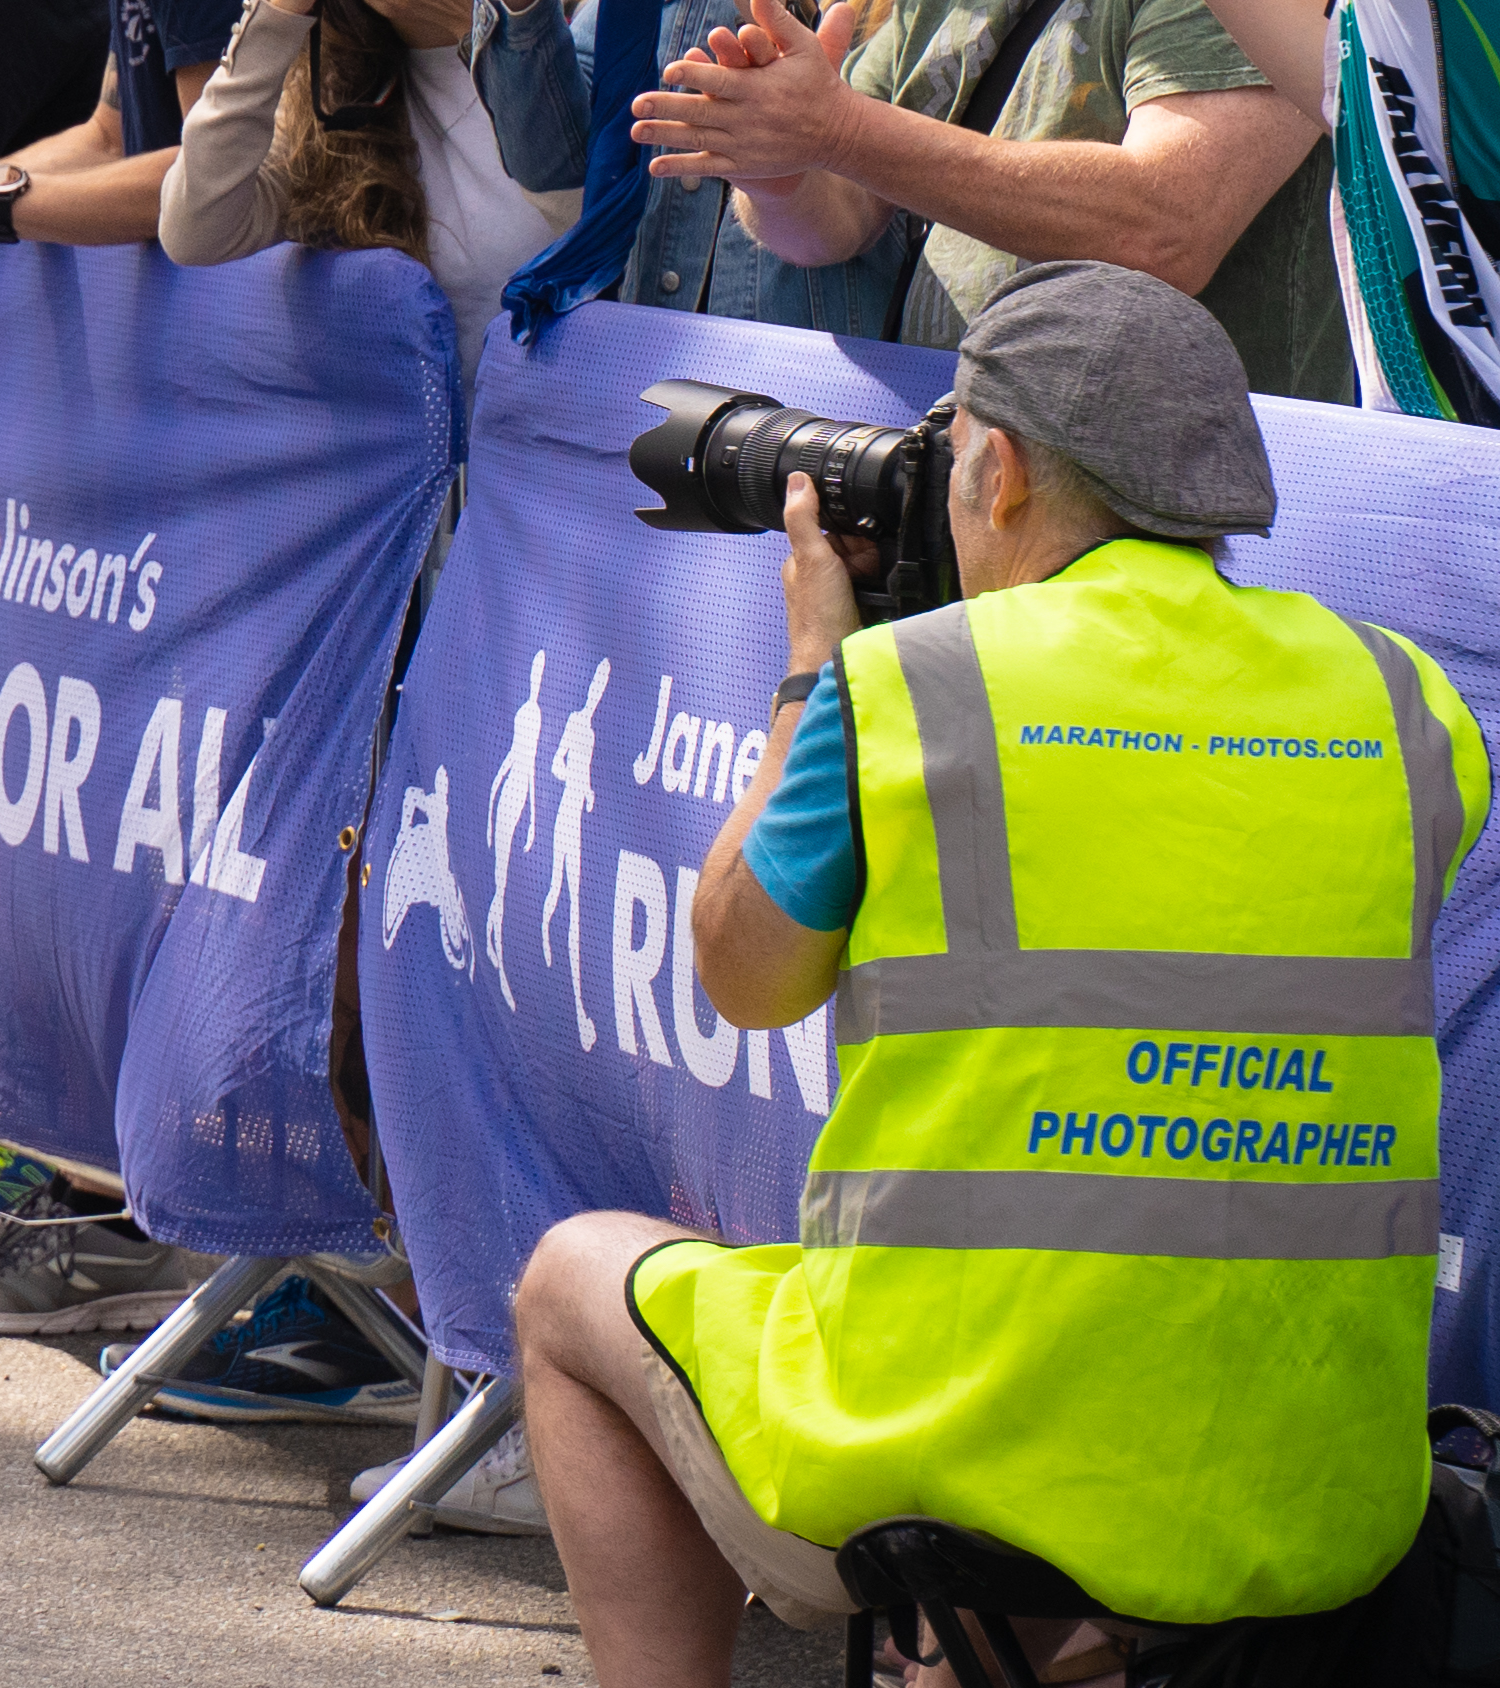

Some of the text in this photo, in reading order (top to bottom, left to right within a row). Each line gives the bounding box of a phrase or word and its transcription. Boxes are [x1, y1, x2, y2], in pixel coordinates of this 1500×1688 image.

[1020, 724, 1184, 753] MARATHON
[1208, 736, 1384, 759] PHOTOS.COM
[113, 696, 277, 903] ALL
[1125, 1040, 1334, 1094] OFFICIAL
[1027, 1110, 1398, 1168] PHOTOGRAPHER
